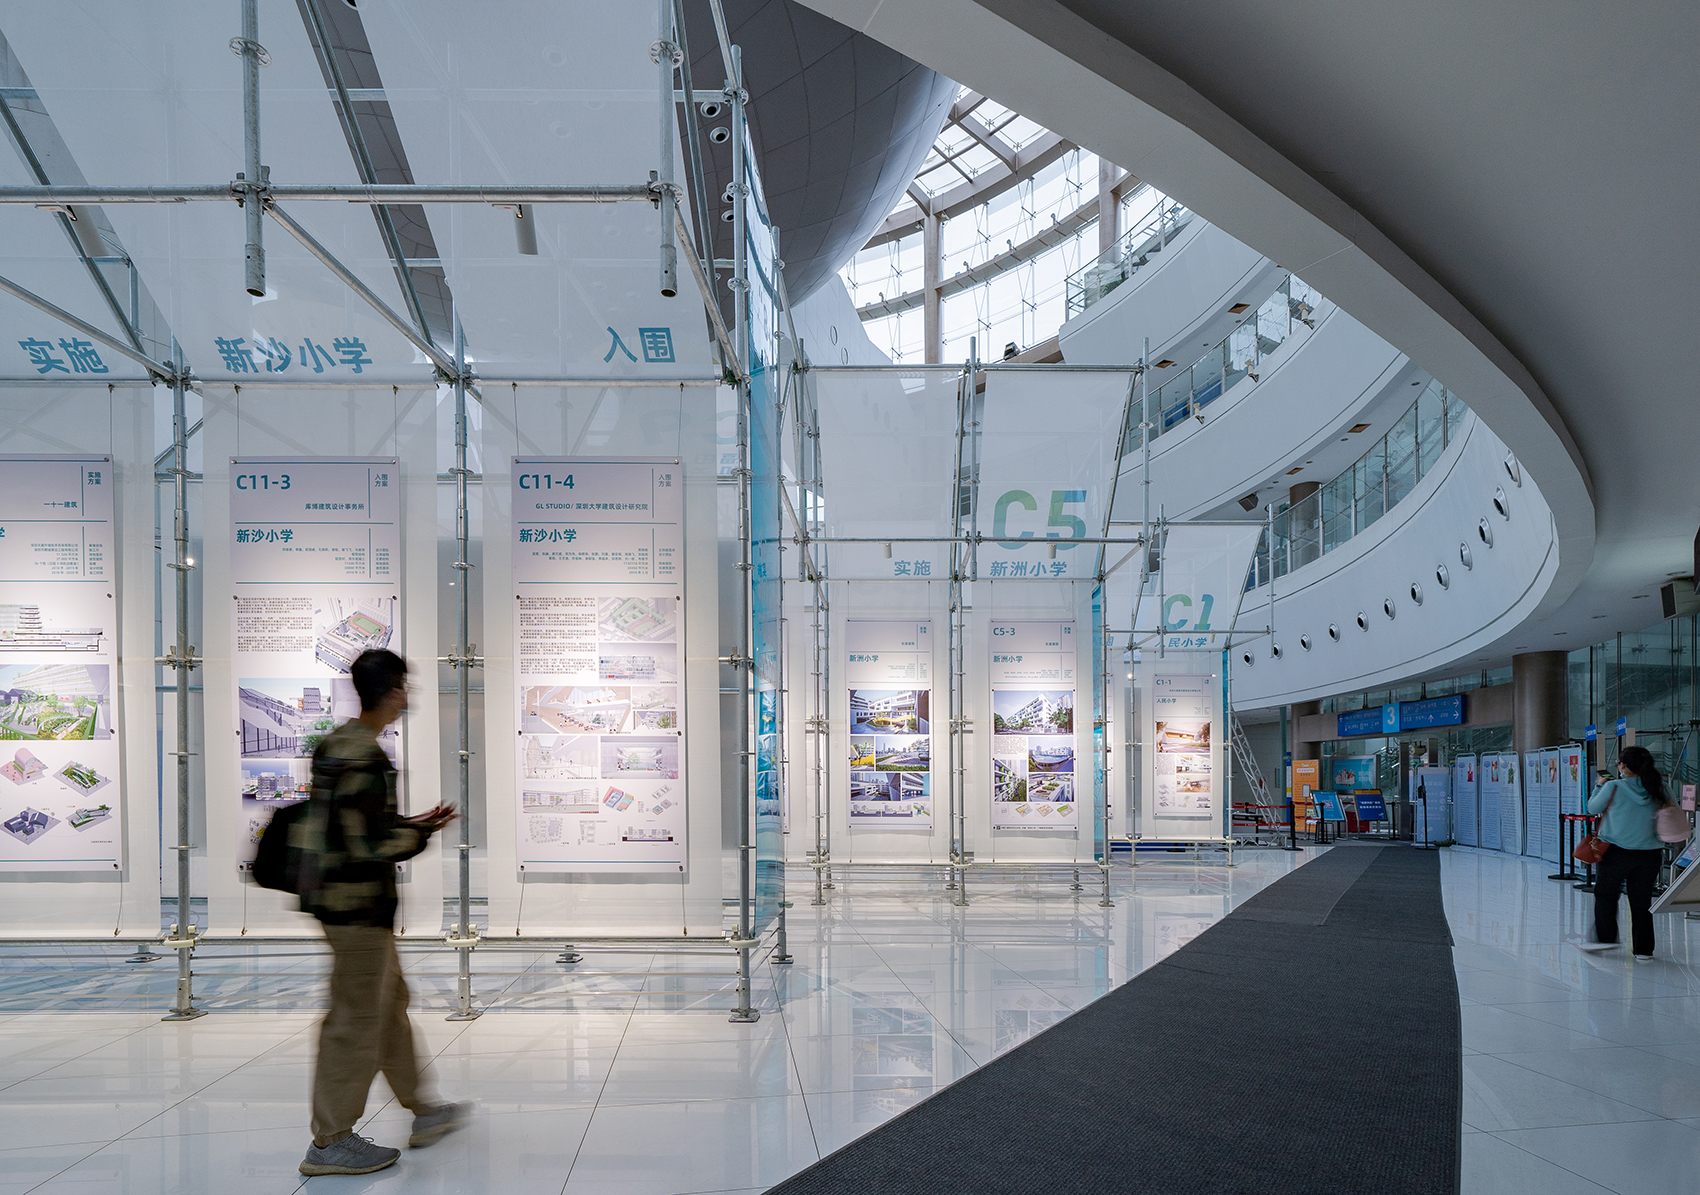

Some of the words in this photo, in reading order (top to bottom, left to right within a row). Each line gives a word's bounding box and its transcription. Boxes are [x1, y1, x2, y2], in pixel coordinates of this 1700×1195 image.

[604, 326, 675, 363] 入围
[18, 336, 109, 374] 实施
[214, 336, 373, 374] 新沙小学
[236, 474, 291, 490] C11-3
[518, 474, 575, 490] C11-4
[575, 503, 649, 511] 深圳大学建筑设计研究院
[992, 489, 1088, 551] C5
[236, 529, 294, 543] 新沙小学
[519, 528, 577, 543] 新沙小学
[893, 559, 931, 577] 实施
[989, 560, 1068, 577] 新洲小学
[1164, 593, 1215, 631] C1
[993, 627, 1016, 636] C5-3
[849, 654, 879, 662] 新洲小学
[993, 655, 1023, 663] 新洲小学
[1387, 706, 1396, 725] 3
